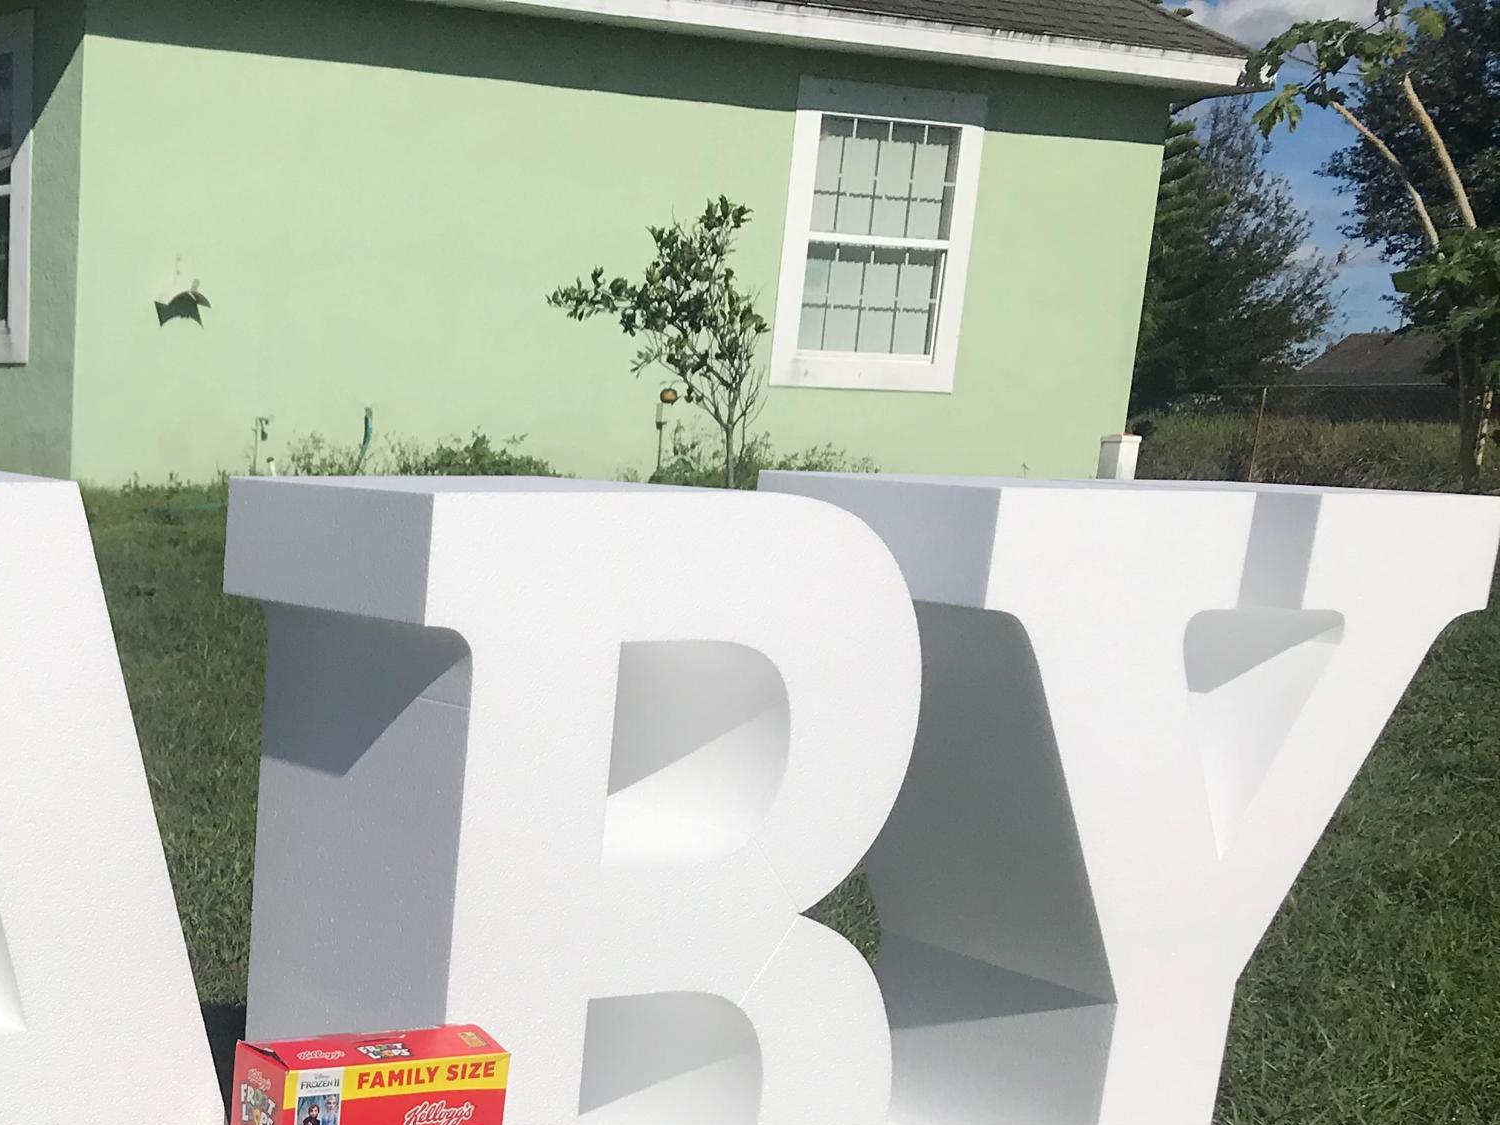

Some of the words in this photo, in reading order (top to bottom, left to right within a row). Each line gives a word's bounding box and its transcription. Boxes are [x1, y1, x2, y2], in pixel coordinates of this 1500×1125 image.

[300, 1080, 333, 1090] FROZEN
[357, 1066, 440, 1090] FAMILY
[446, 1061, 496, 1082] SIZE
[241, 1083, 276, 1116] FROOT
